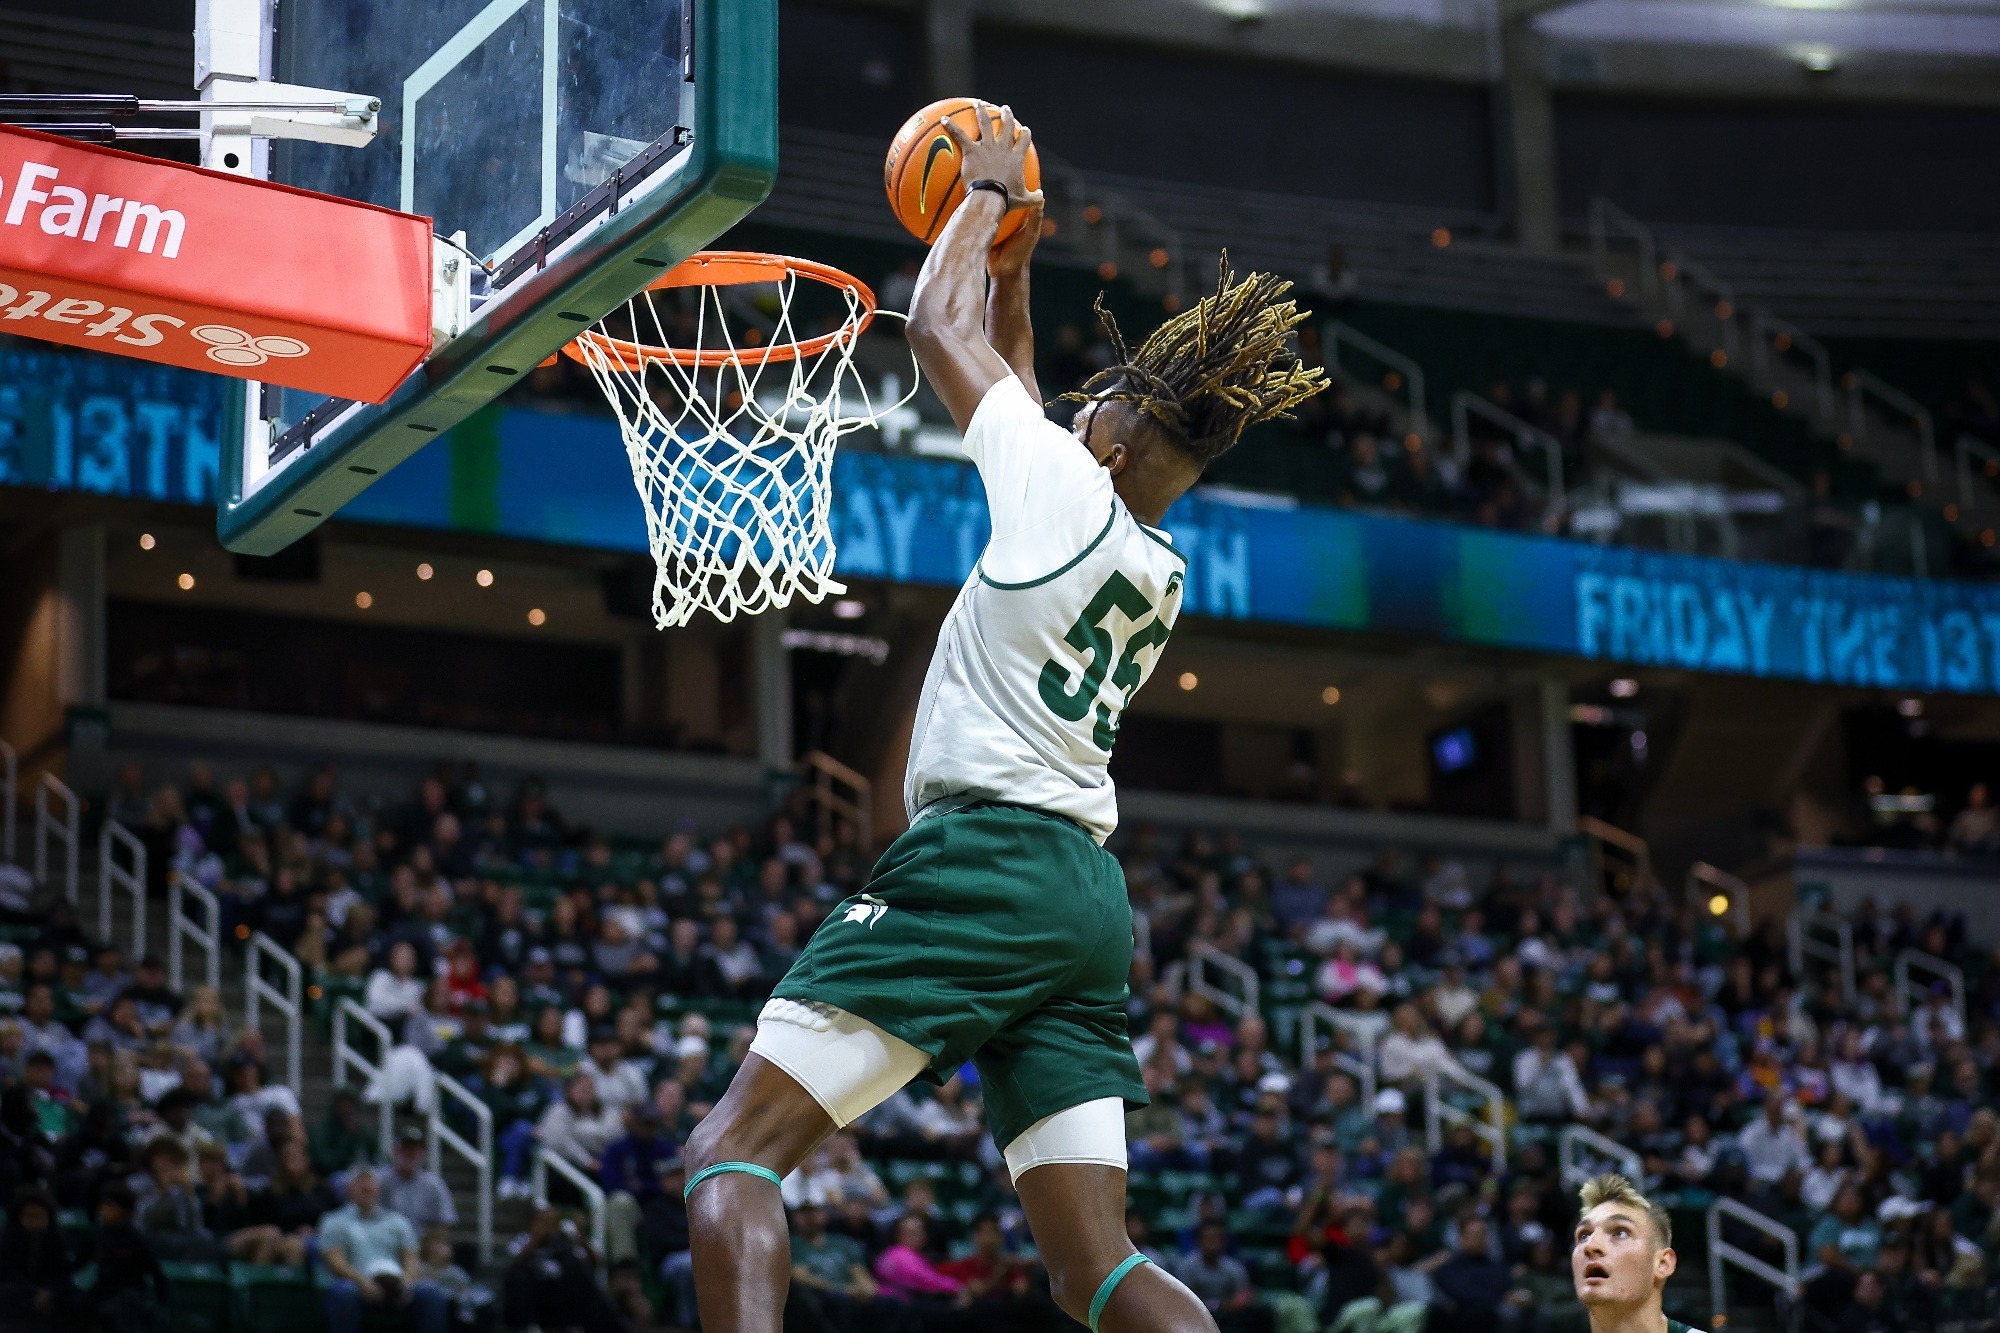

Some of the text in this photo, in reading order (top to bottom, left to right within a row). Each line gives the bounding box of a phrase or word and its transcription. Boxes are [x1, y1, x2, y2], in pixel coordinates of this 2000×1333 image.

[4, 161, 187, 259] Farm
[1038, 569, 1171, 751] 55
[1575, 572, 1776, 677] FRIDAY
[1790, 594, 1900, 688] THE
